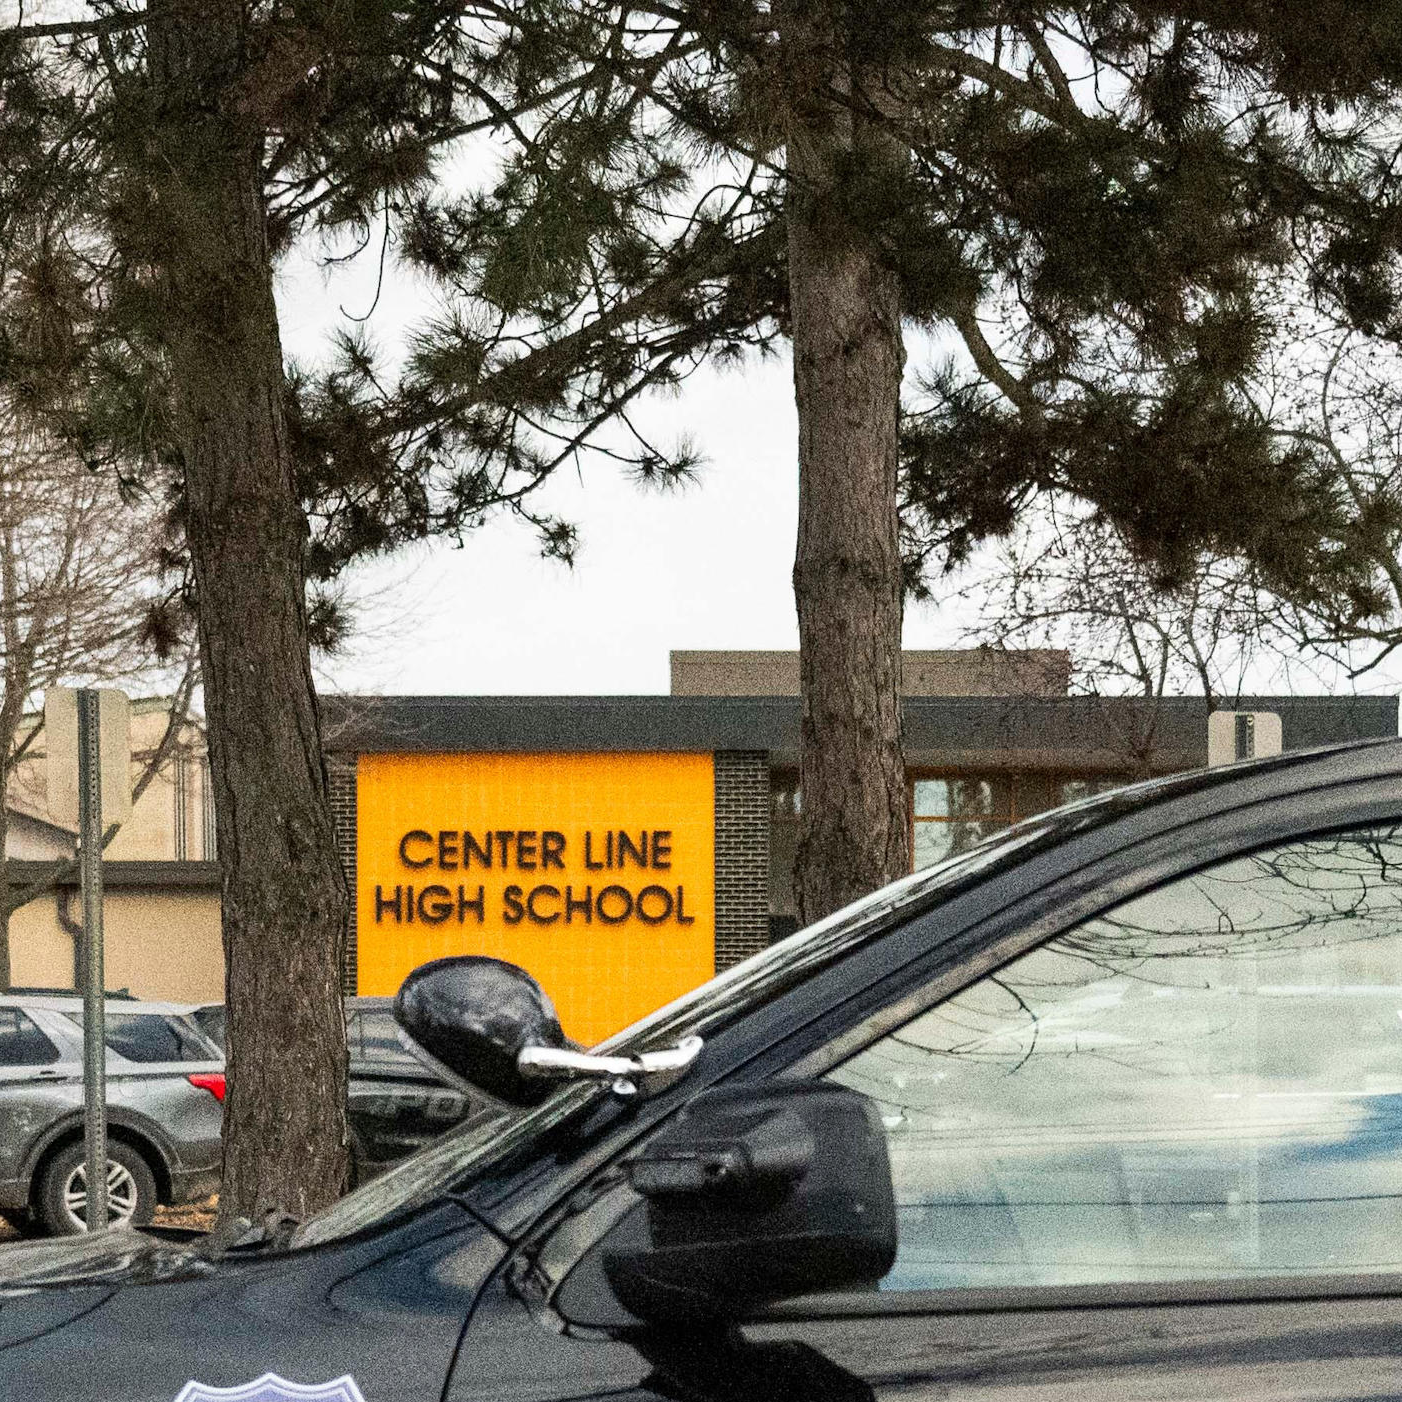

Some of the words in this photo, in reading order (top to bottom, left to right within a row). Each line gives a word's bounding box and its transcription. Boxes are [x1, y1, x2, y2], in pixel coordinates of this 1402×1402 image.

[398, 829, 567, 870] CENTER
[584, 830, 672, 870] LINE
[374, 884, 485, 925] HIGH
[502, 884, 695, 926] SCHOOL
